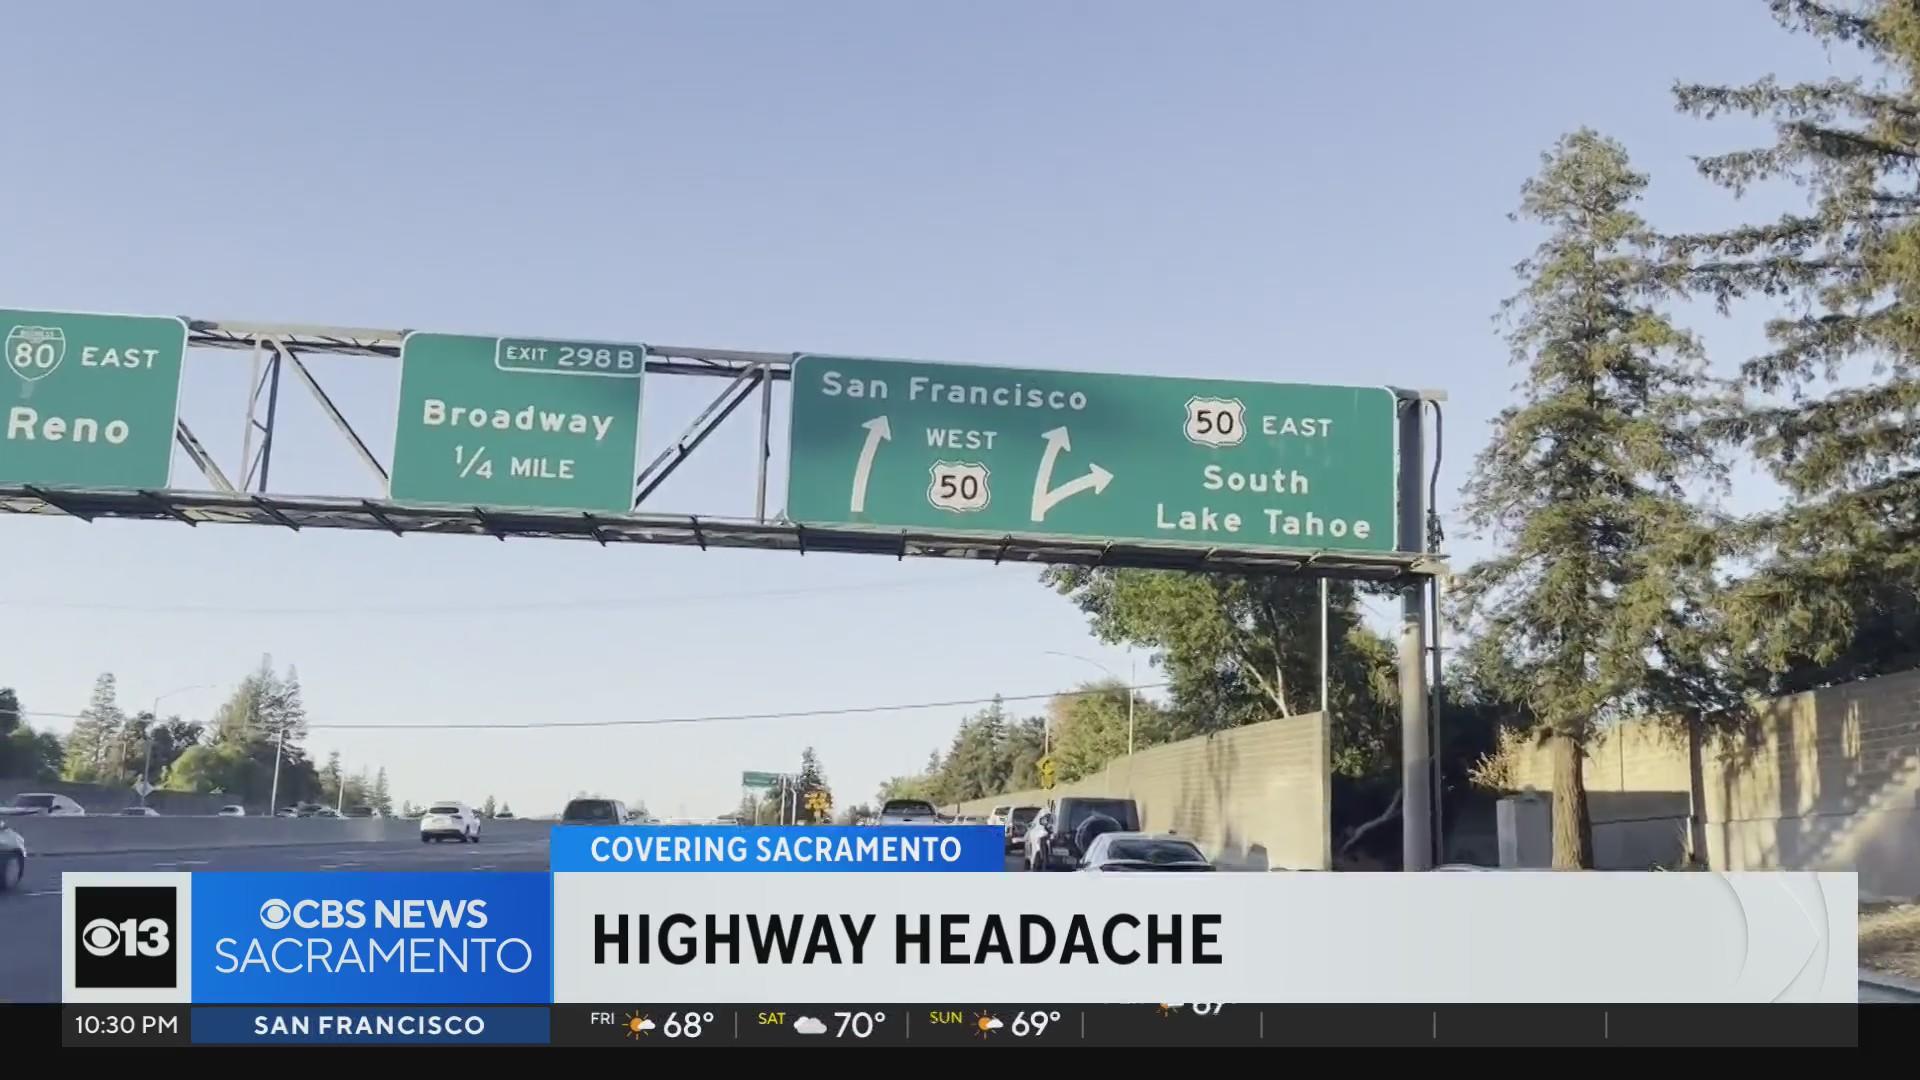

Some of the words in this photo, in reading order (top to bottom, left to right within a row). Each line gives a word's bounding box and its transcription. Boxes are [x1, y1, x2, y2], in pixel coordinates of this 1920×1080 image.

[14, 342, 55, 368] 80
[81, 346, 159, 369] EAST
[506, 346, 548, 361] EXIT
[821, 371, 888, 399] San
[909, 376, 1087, 410] Francisco
[7, 406, 129, 444] Reno
[423, 399, 613, 440] Broadway
[1196, 409, 1234, 435] 50
[1263, 415, 1333, 437] EAST
[926, 427, 998, 450] WEST
[510, 456, 575, 479] MILE
[1203, 464, 1308, 494] South
[940, 475, 978, 500] 50
[1156, 503, 1242, 532] Lake
[1264, 509, 1371, 539] Tahoe
